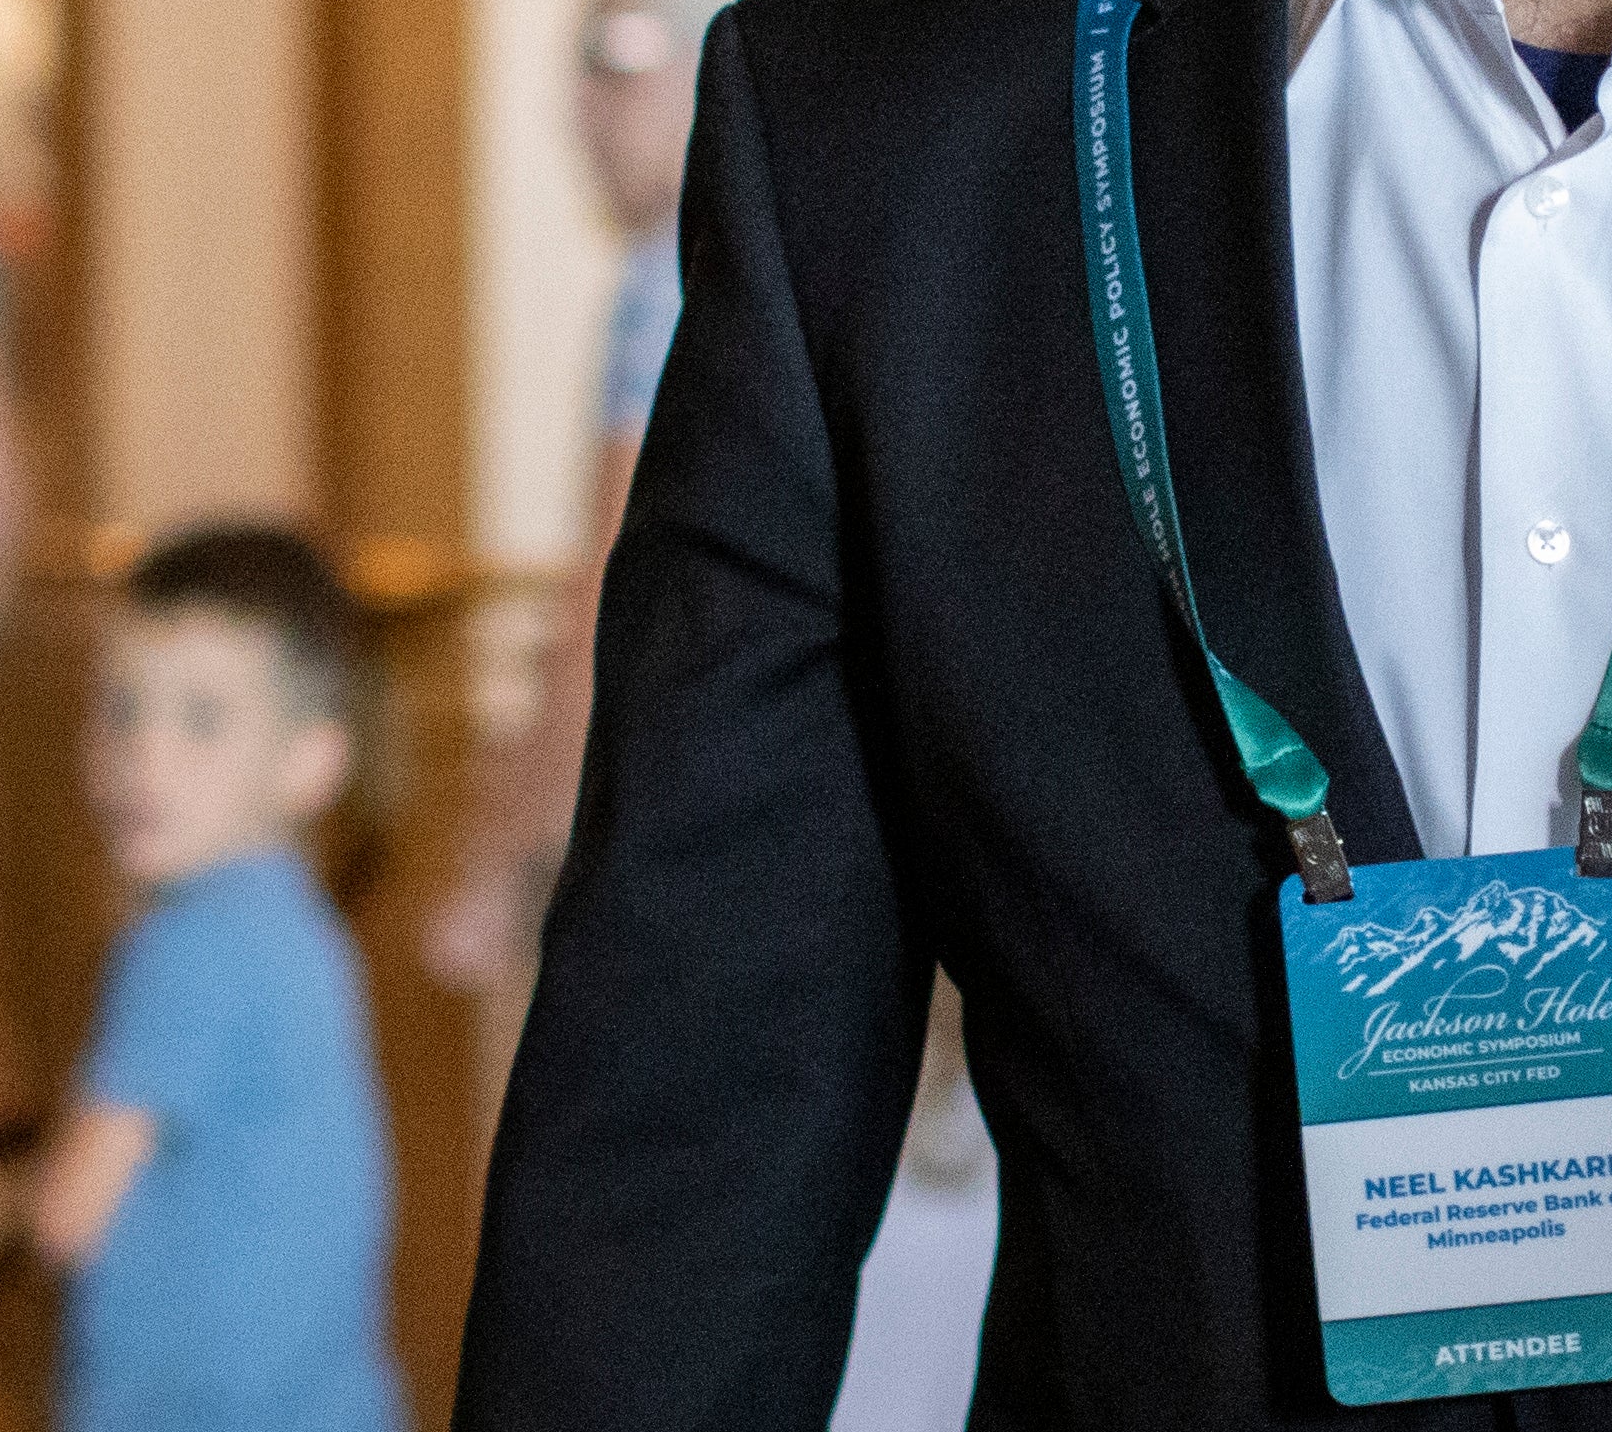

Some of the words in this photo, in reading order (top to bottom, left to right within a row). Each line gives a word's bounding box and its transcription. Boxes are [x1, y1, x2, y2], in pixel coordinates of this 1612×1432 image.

[1089, 49, 1113, 212] SYMPOSIUM
[1099, 222, 1127, 321] POLICY
[1112, 326, 1151, 480] ECONOMIC
[1142, 484, 1171, 563] HOLE
[1338, 963, 1511, 1081] Jackson
[1381, 1040, 1475, 1064] ECONOMIC
[1476, 1031, 1582, 1055] SYMPOSIUM
[1408, 1074, 1480, 1094] KANSAS
[1482, 1071, 1524, 1087] CITY
[1525, 1065, 1561, 1083] FED
[1363, 1171, 1446, 1201] NEEL
[1355, 1206, 1441, 1232] Federal
[1446, 1199, 1539, 1222] Reserve
[1543, 1189, 1604, 1213] Bank
[1426, 1218, 1567, 1252] Minneapolis
[1434, 1331, 1583, 1367] ATTENDEE
